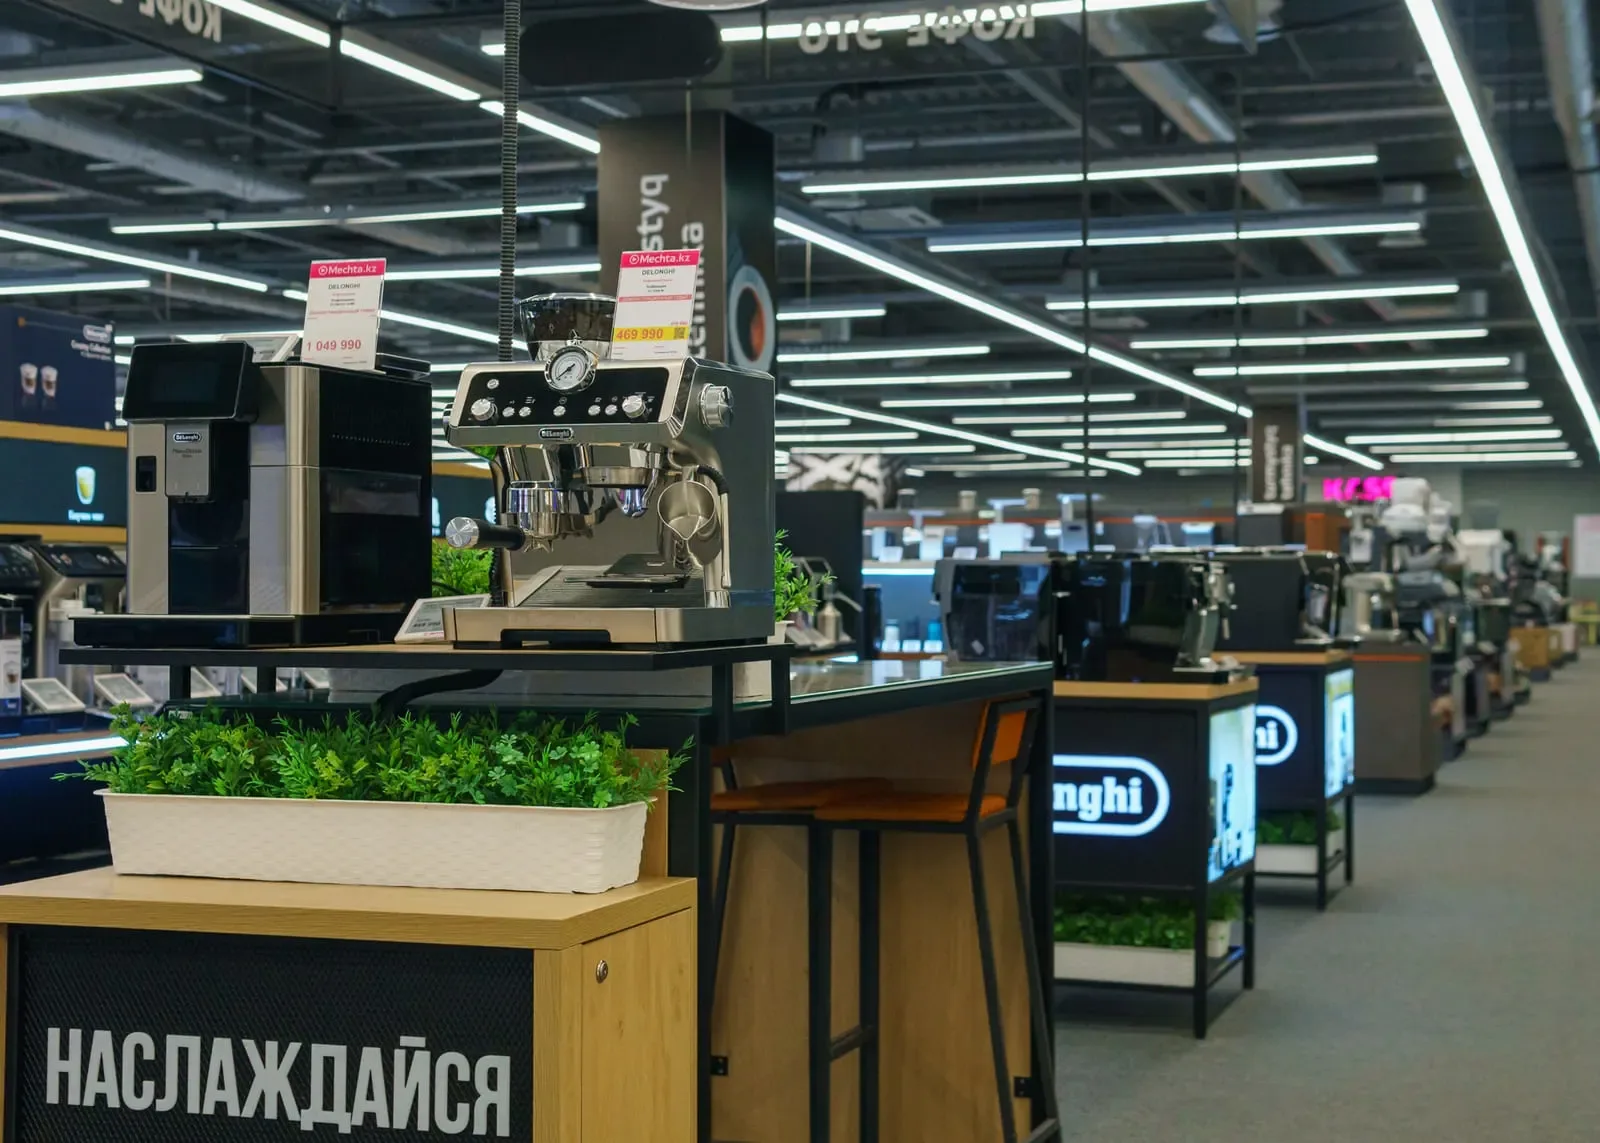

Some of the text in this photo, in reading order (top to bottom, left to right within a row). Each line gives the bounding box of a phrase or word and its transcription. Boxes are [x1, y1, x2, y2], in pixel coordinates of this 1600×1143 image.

[639, 254, 691, 264] Mechta.kz
[328, 265, 377, 275] Mechta.kz
[641, 268, 676, 276] DELONGHI
[616, 328, 664, 340] 469 990
[316, 340, 337, 351] 049
[340, 339, 362, 350] 990
[46, 1026, 511, 1137] НАСЛАЖДАЙСЯ
